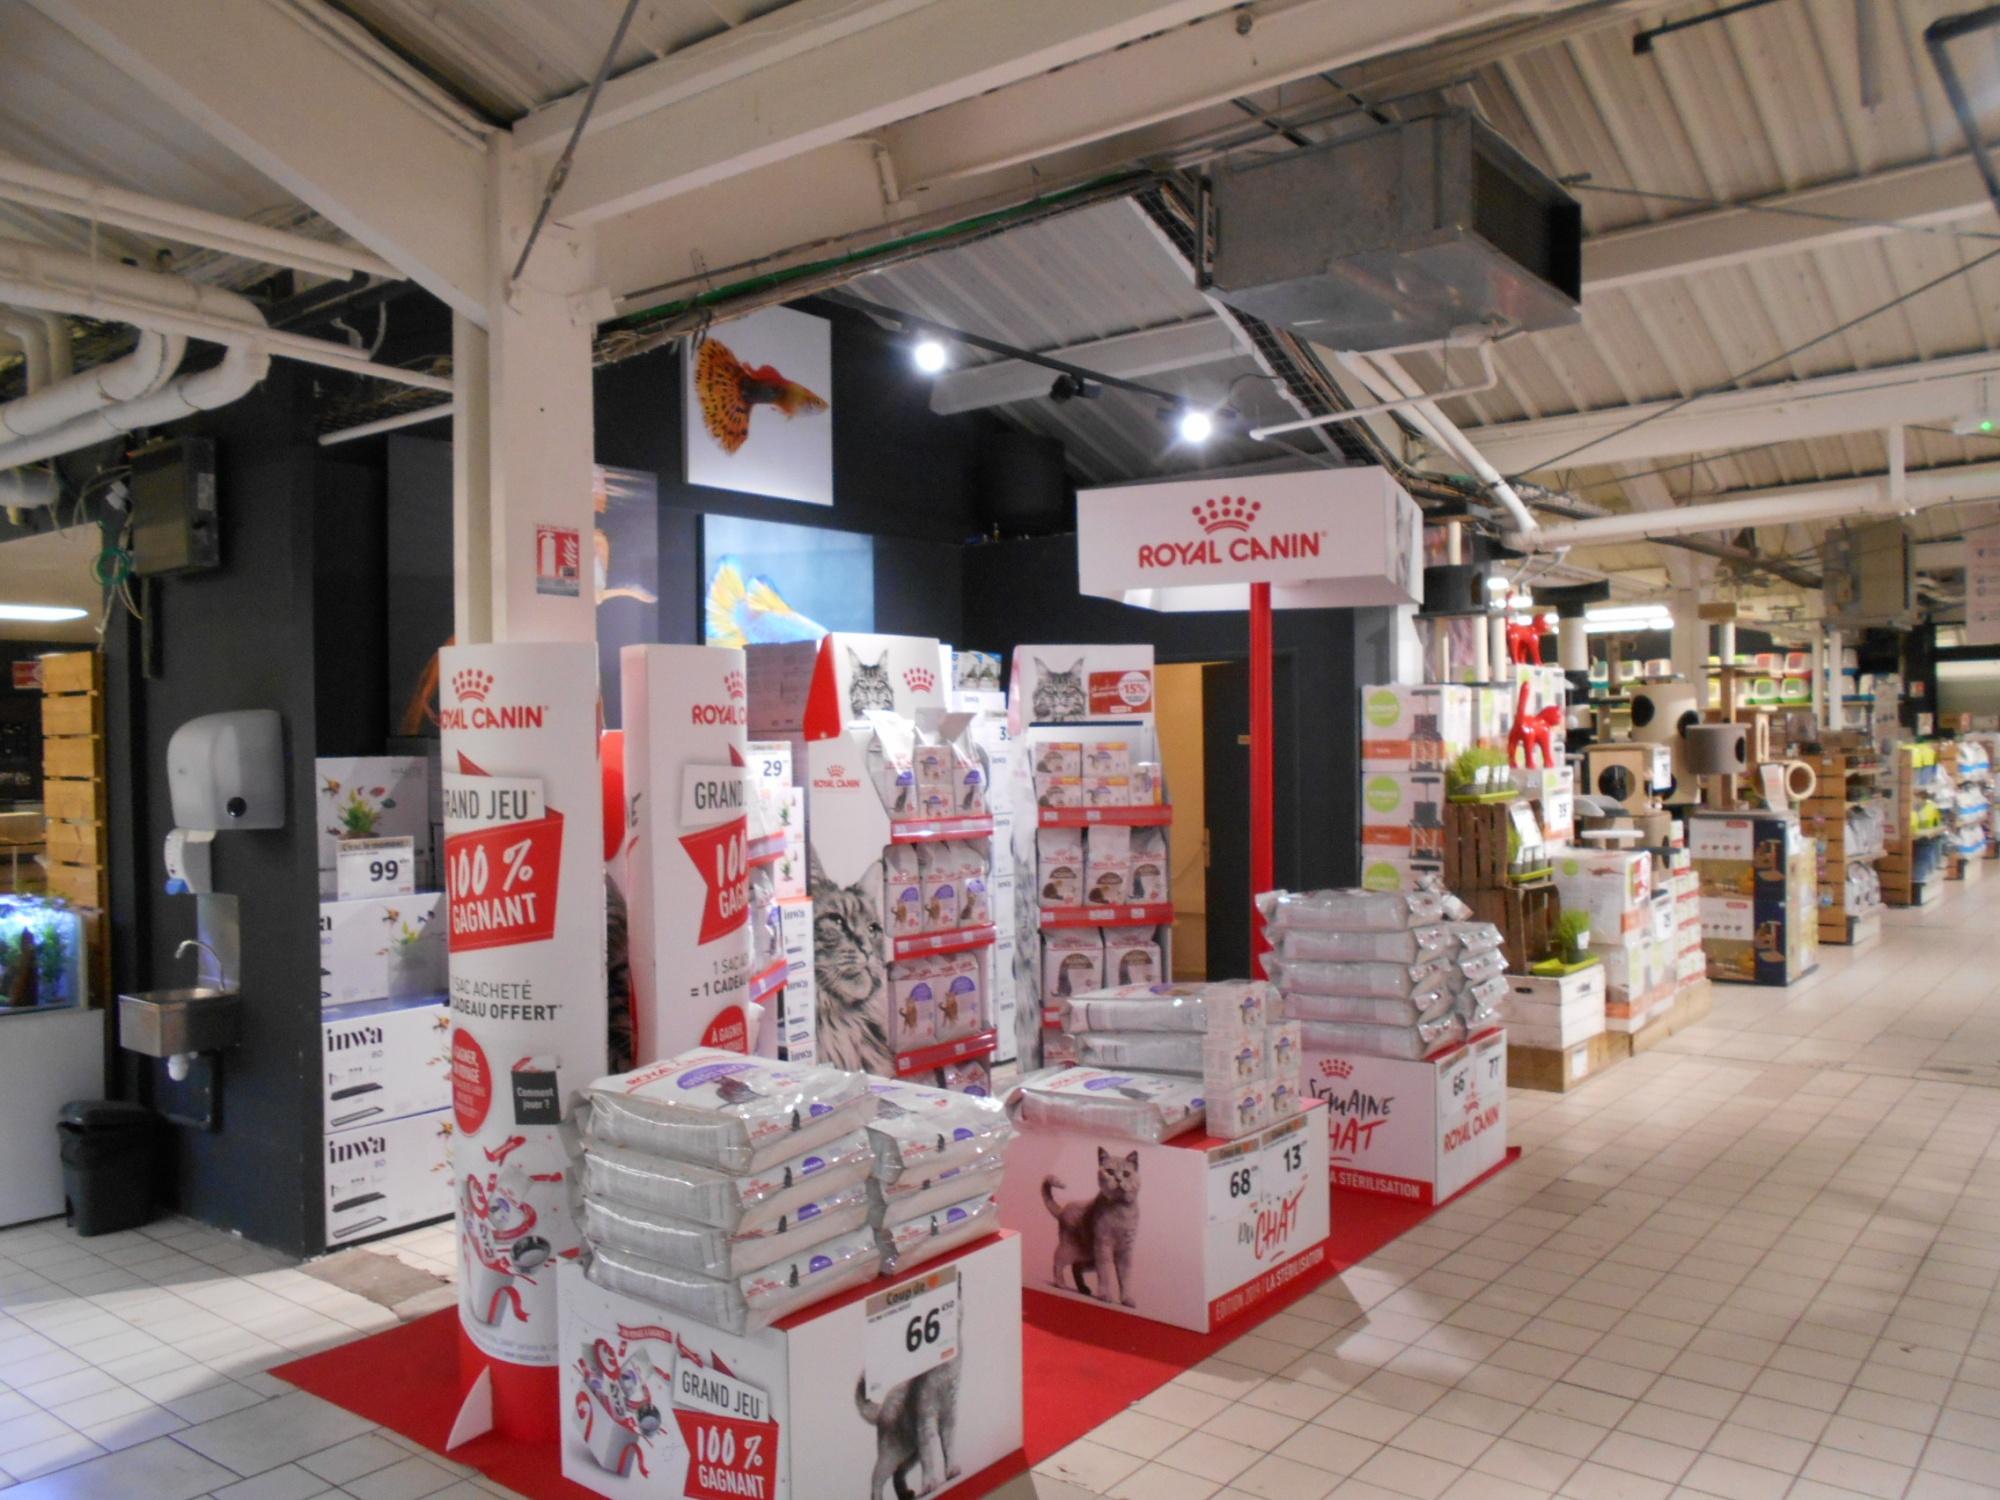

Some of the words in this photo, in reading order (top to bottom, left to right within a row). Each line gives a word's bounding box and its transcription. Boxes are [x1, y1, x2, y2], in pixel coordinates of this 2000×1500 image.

[1138, 541, 1222, 568] ROYAL
[1229, 532, 1321, 562] CANIN
[441, 708, 469, 730] OYAL
[472, 705, 542, 729] CANIN
[692, 704, 737, 725] ROYAL
[763, 760, 782, 777] 29
[486, 790, 528, 820] JEU
[370, 860, 398, 882] 99
[450, 844, 489, 901] 100
[502, 838, 534, 892] %
[452, 892, 536, 934] GAGNANT
[473, 979, 533, 1000] ACHETÉ
[489, 1003, 558, 1021] OFFERT
[327, 1026, 384, 1052] inwa
[329, 1136, 387, 1164] inwa
[1328, 1116, 1388, 1154] HAT
[1444, 1121, 1472, 1153] ROYAL
[1283, 1143, 1302, 1173] 13
[1230, 1168, 1251, 1198] 68
[906, 1308, 941, 1352] 66
[682, 1371, 730, 1408] GRAND
[733, 1391, 760, 1419] JEU
[697, 1425, 736, 1466] 100
[743, 1435, 764, 1470] %
[698, 1464, 765, 1500] GAGNANT
